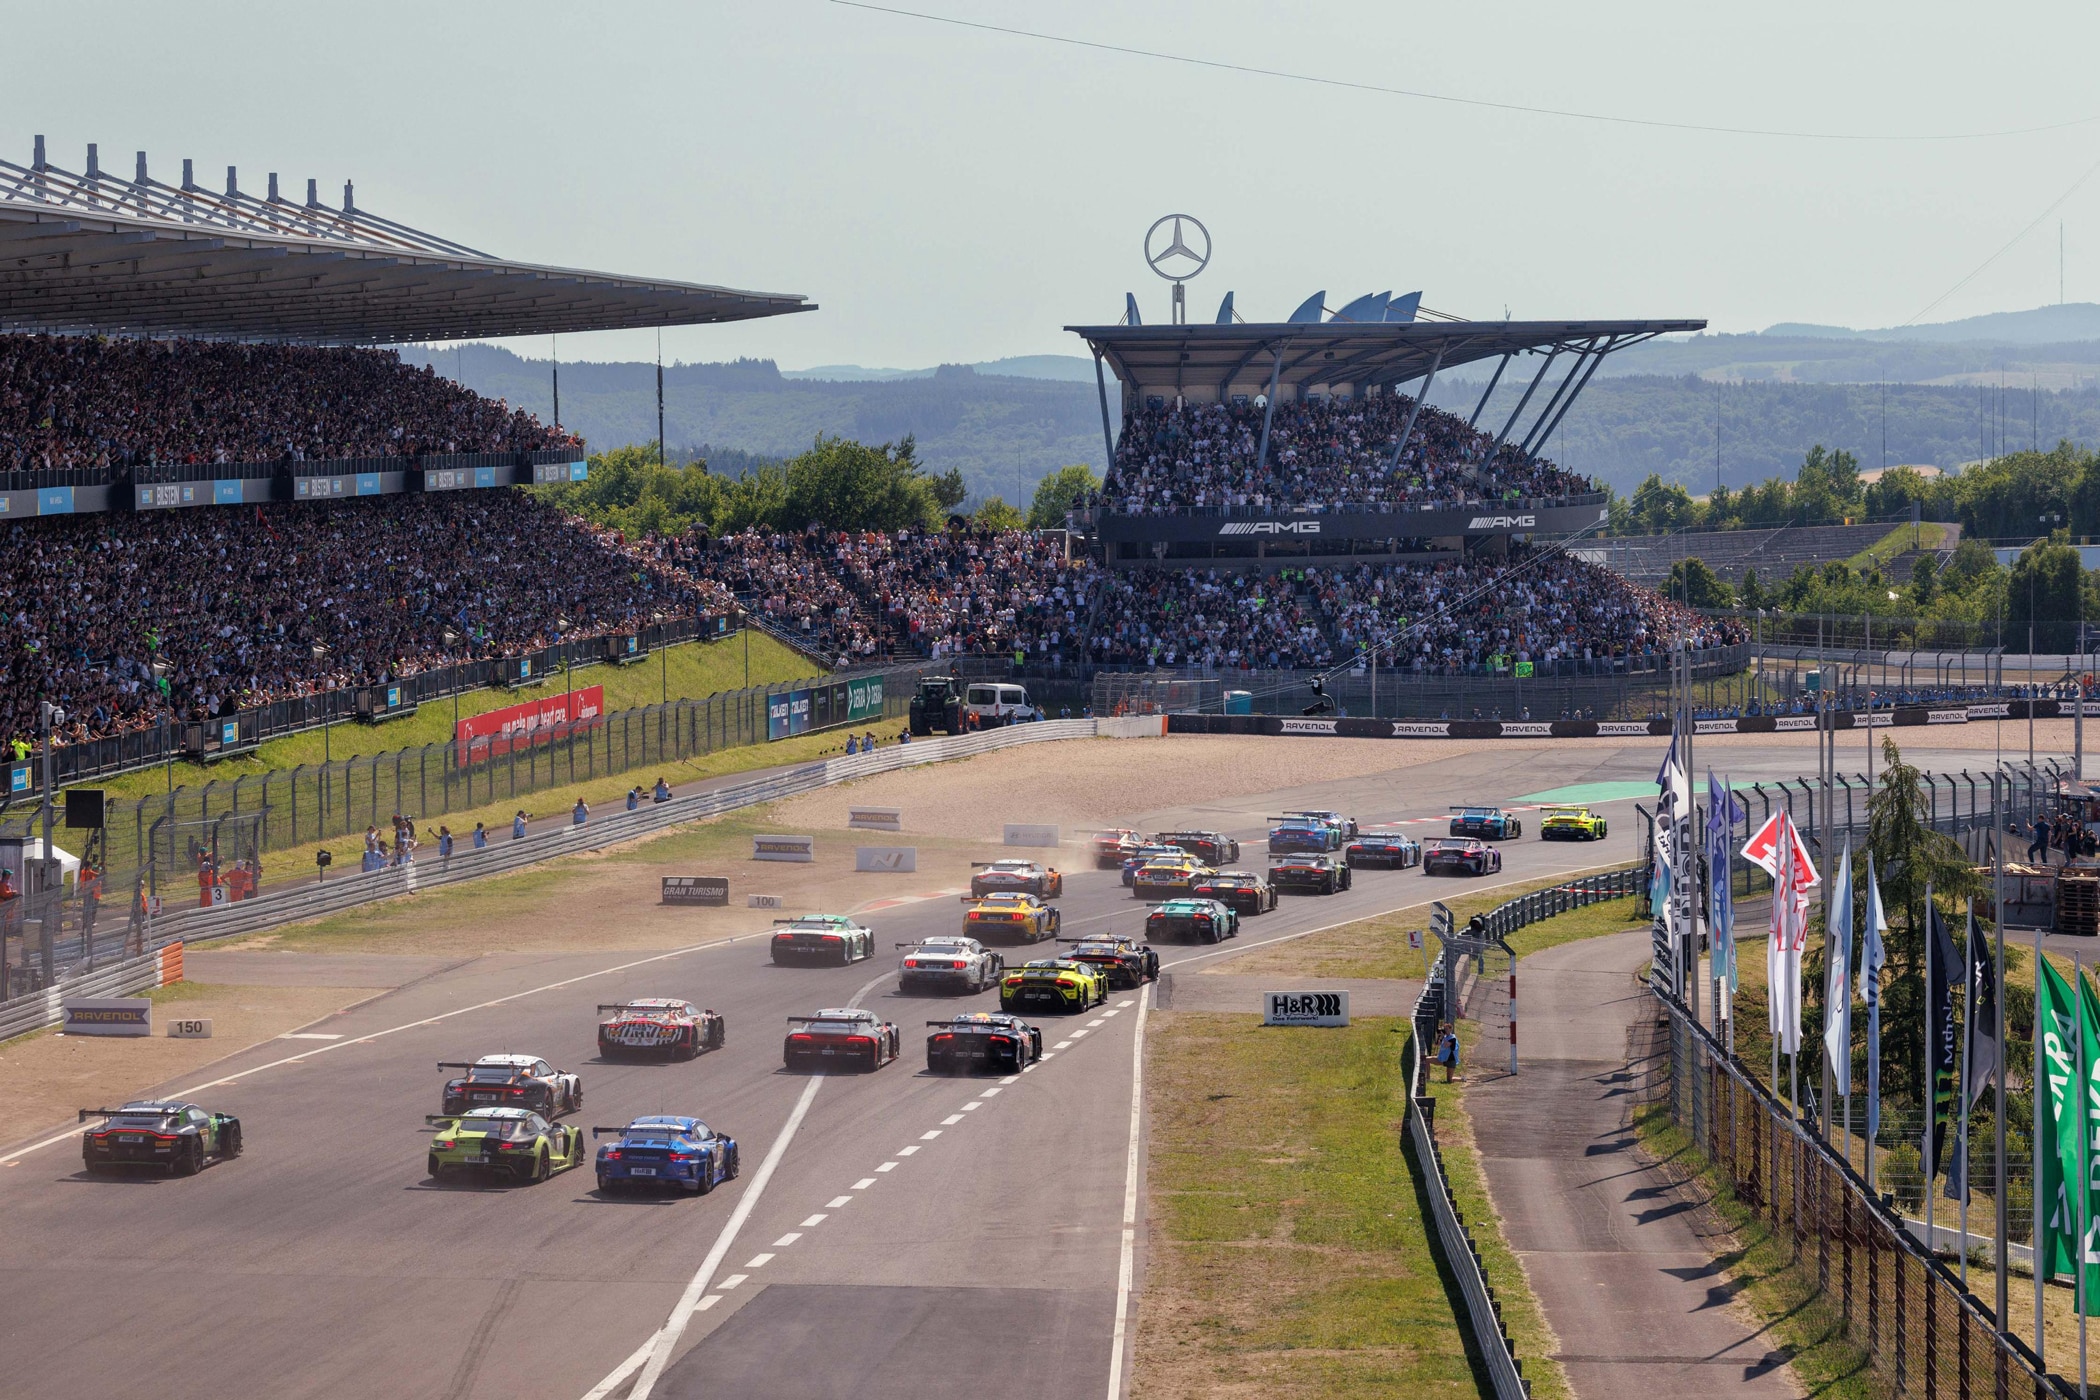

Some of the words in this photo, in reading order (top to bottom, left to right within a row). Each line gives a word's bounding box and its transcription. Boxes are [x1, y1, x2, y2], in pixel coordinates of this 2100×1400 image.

[311, 478, 331, 497] BILSTEIN
[156, 485, 180, 506] BILSTEIN
[1490, 515, 1536, 528] AMG
[1253, 521, 1321, 534] AMG
[1930, 713, 1965, 721] RAVENOL
[1286, 722, 1333, 730] RAVENOL
[1699, 722, 1735, 731] RAVENOL
[1778, 719, 1814, 727] RAVENOL
[1505, 725, 1548, 733] RAVENOL
[854, 813, 895, 821] RAVENOL
[760, 844, 806, 852] RAVENOL
[214, 888, 223, 900] 3
[663, 887, 687, 896] GRAN
[688, 887, 724, 896] TURISMO
[755, 896, 775, 907] 100
[1272, 994, 1318, 1016] H&R
[73, 1012, 141, 1021] RAVENOL
[176, 1021, 203, 1033] 150
